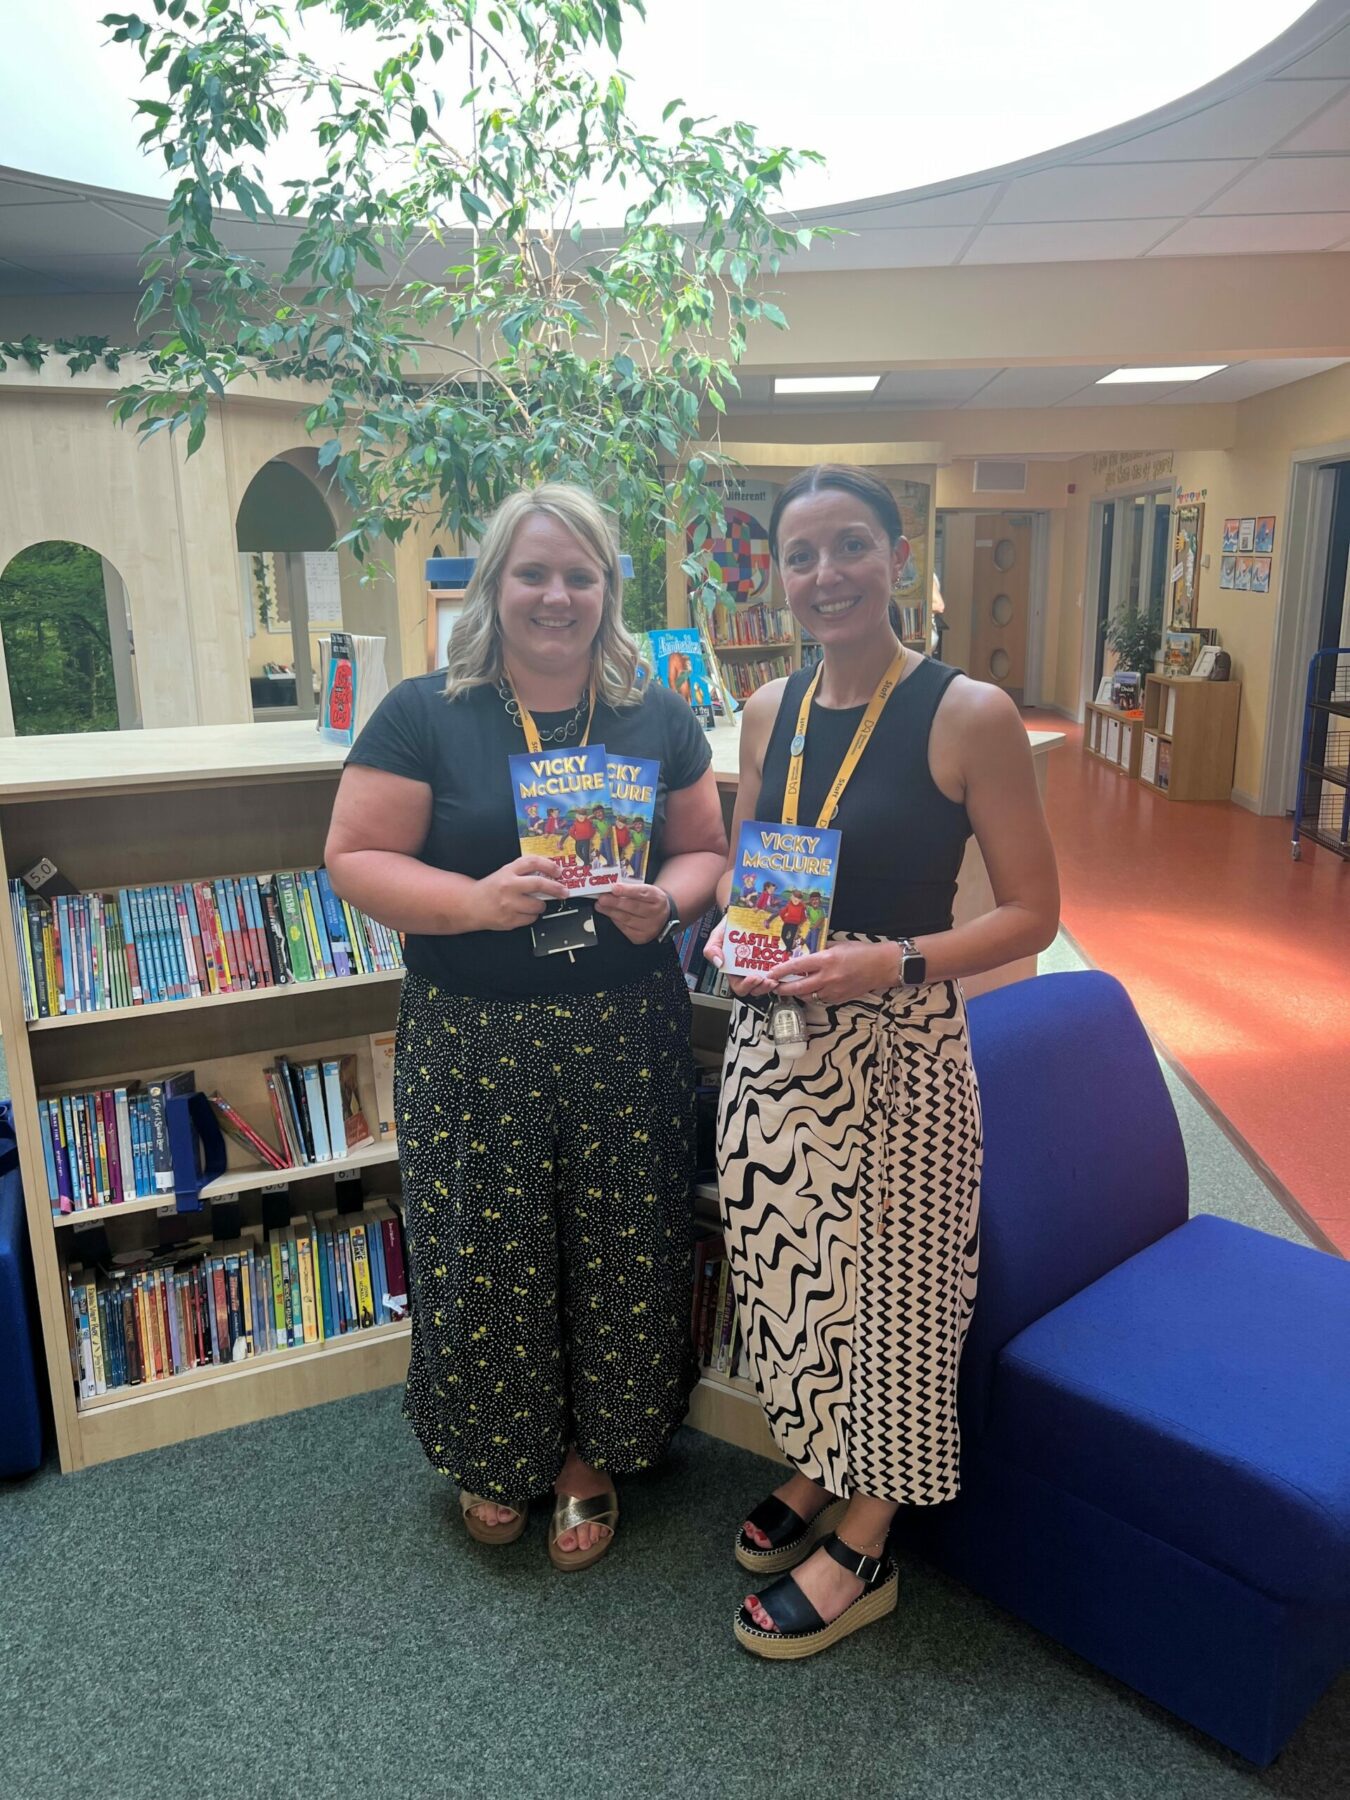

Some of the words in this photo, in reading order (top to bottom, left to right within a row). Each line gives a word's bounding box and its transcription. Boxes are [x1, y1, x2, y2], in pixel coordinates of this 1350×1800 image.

[530, 755, 588, 778] VICKY
[607, 762, 642, 782] CKY
[519, 772, 604, 799] McCLURE
[609, 782, 653, 803] LURE
[760, 831, 821, 854] VICKY
[548, 854, 577, 867] TLE
[743, 850, 832, 876] McCLURE
[30, 863, 52, 884] 5.0
[556, 865, 592, 880] OCK
[589, 873, 618, 886] CREW
[729, 930, 780, 949] CASTLE
[735, 957, 779, 971] MYSTE
[752, 946, 792, 963] ROCK
